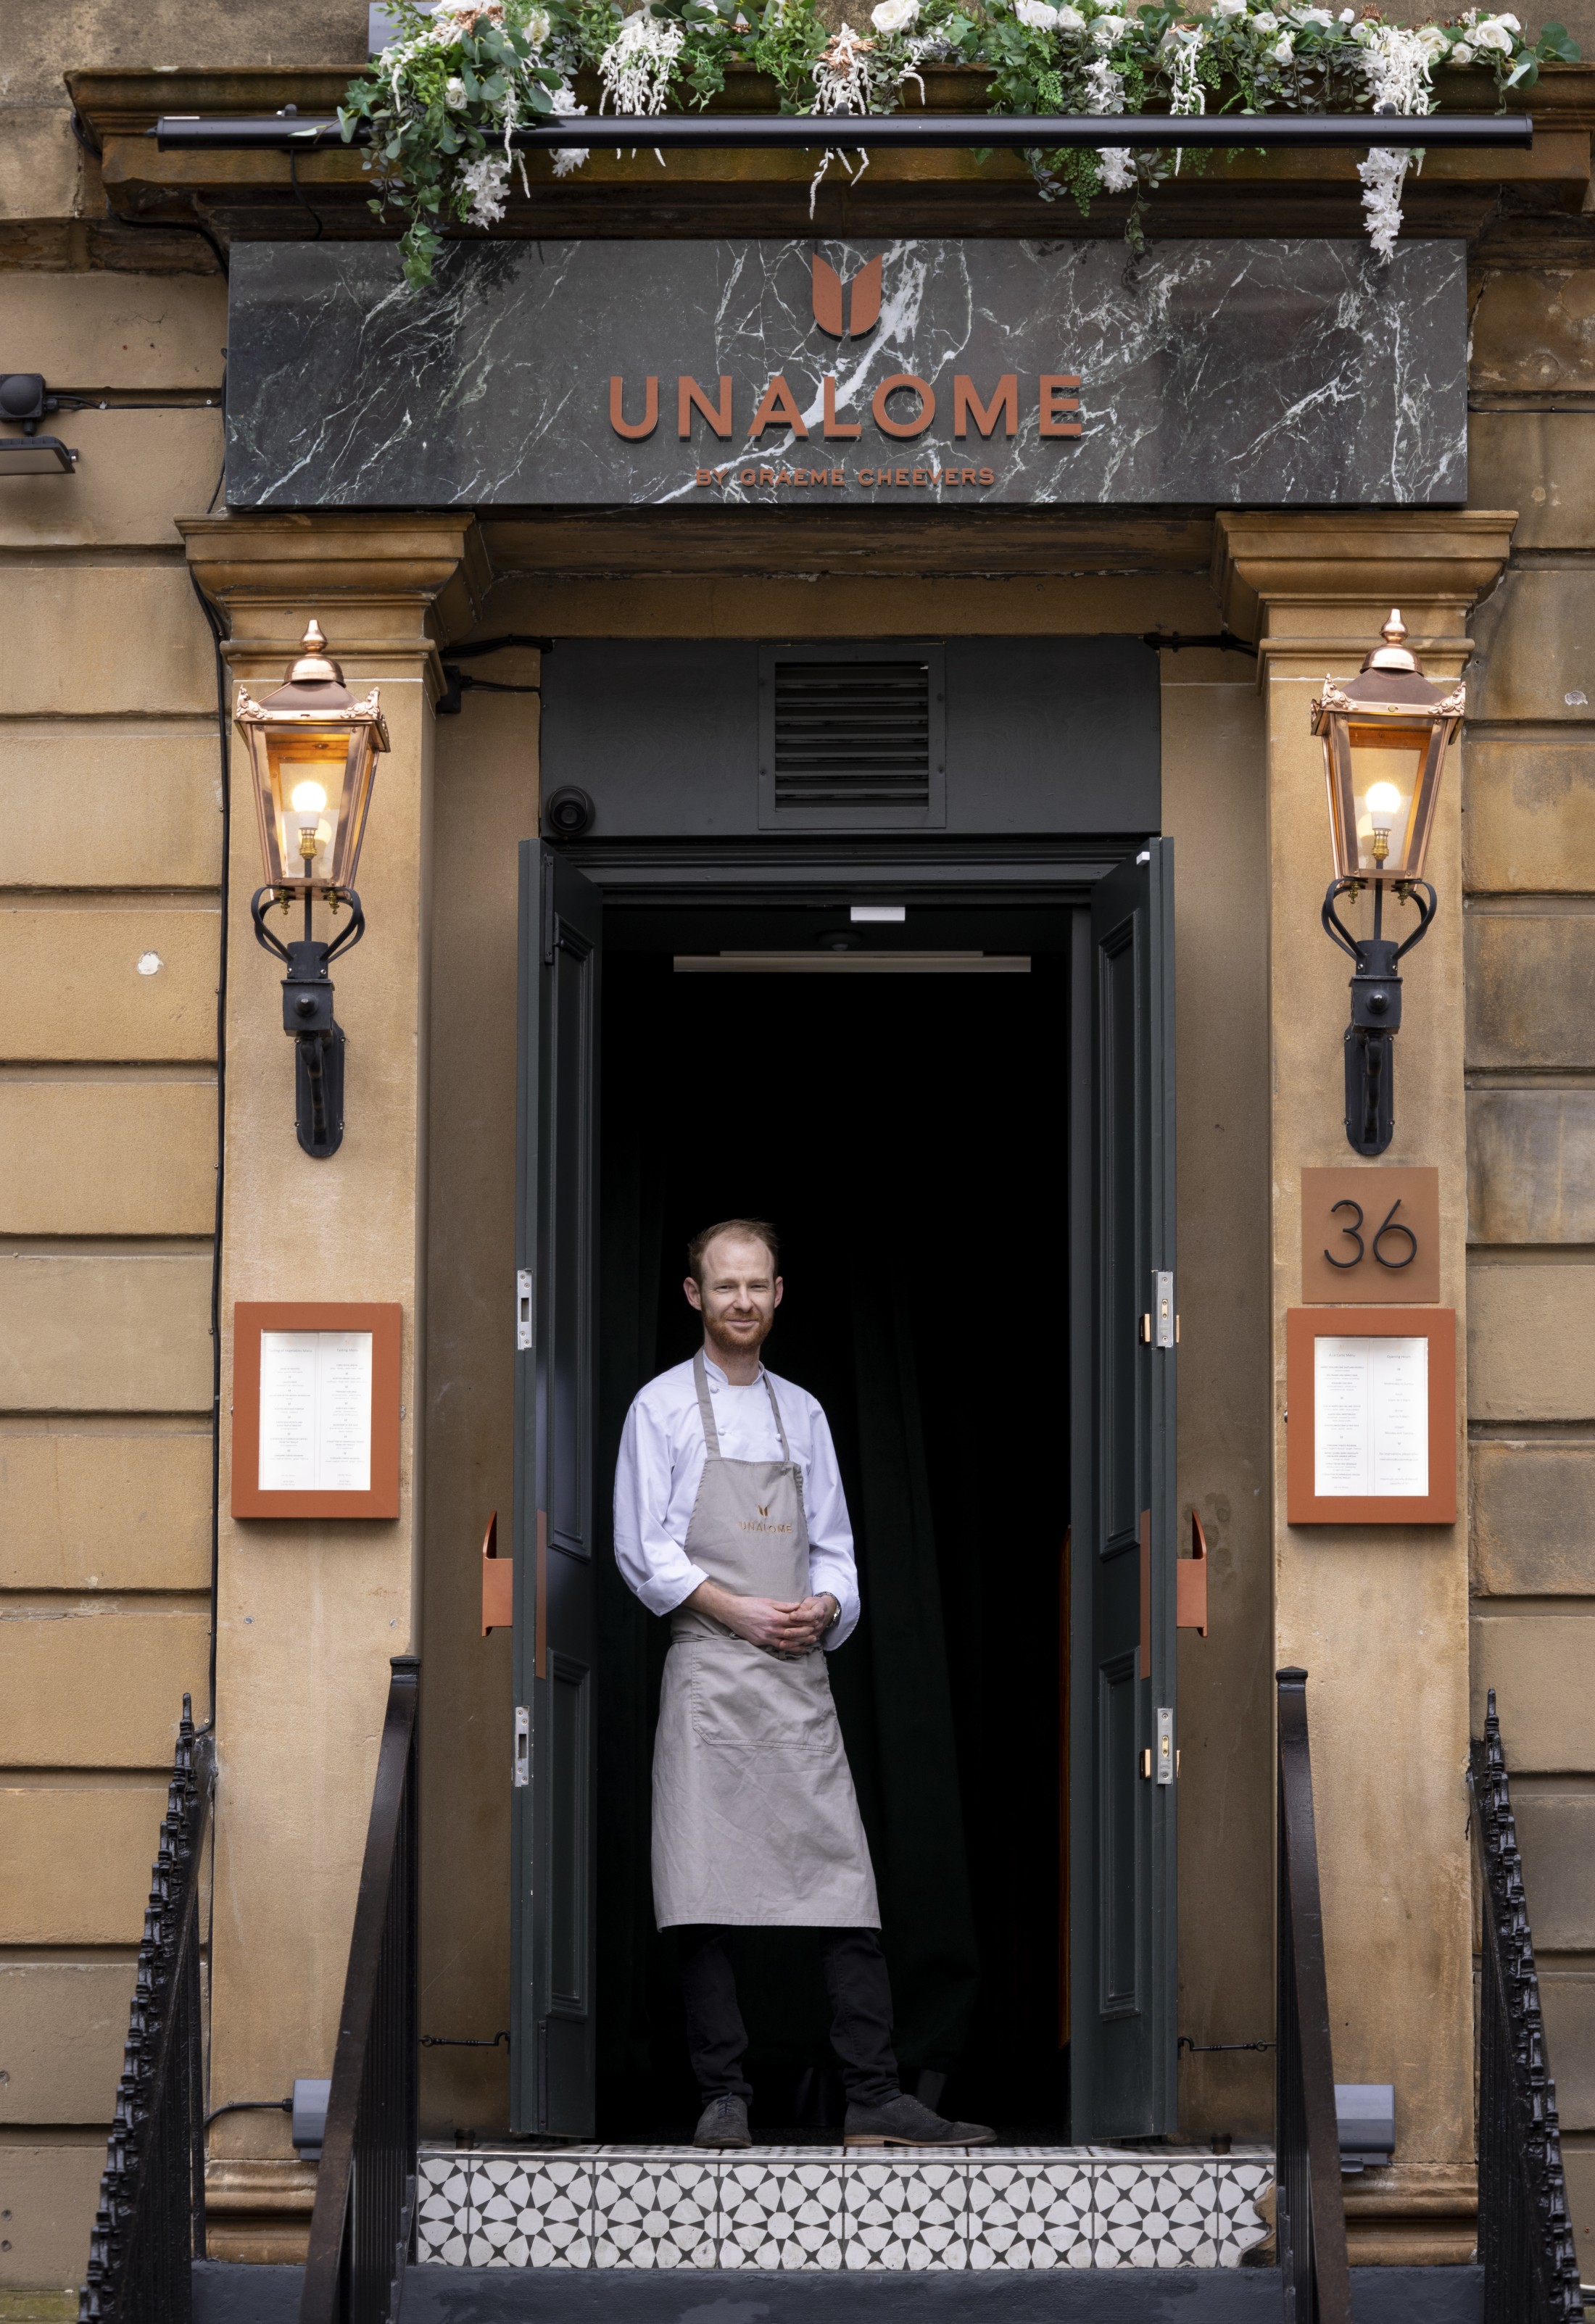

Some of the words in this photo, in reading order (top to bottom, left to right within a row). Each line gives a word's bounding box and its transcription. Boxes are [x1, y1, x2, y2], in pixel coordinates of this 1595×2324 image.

[609, 373, 1082, 438] UNALOME
[695, 468, 729, 486] BY
[740, 468, 846, 486] GRAEME
[858, 468, 995, 487] CHEEVERS
[1325, 1199, 1417, 1268] 36
[739, 1521, 793, 1534] UNALOME
